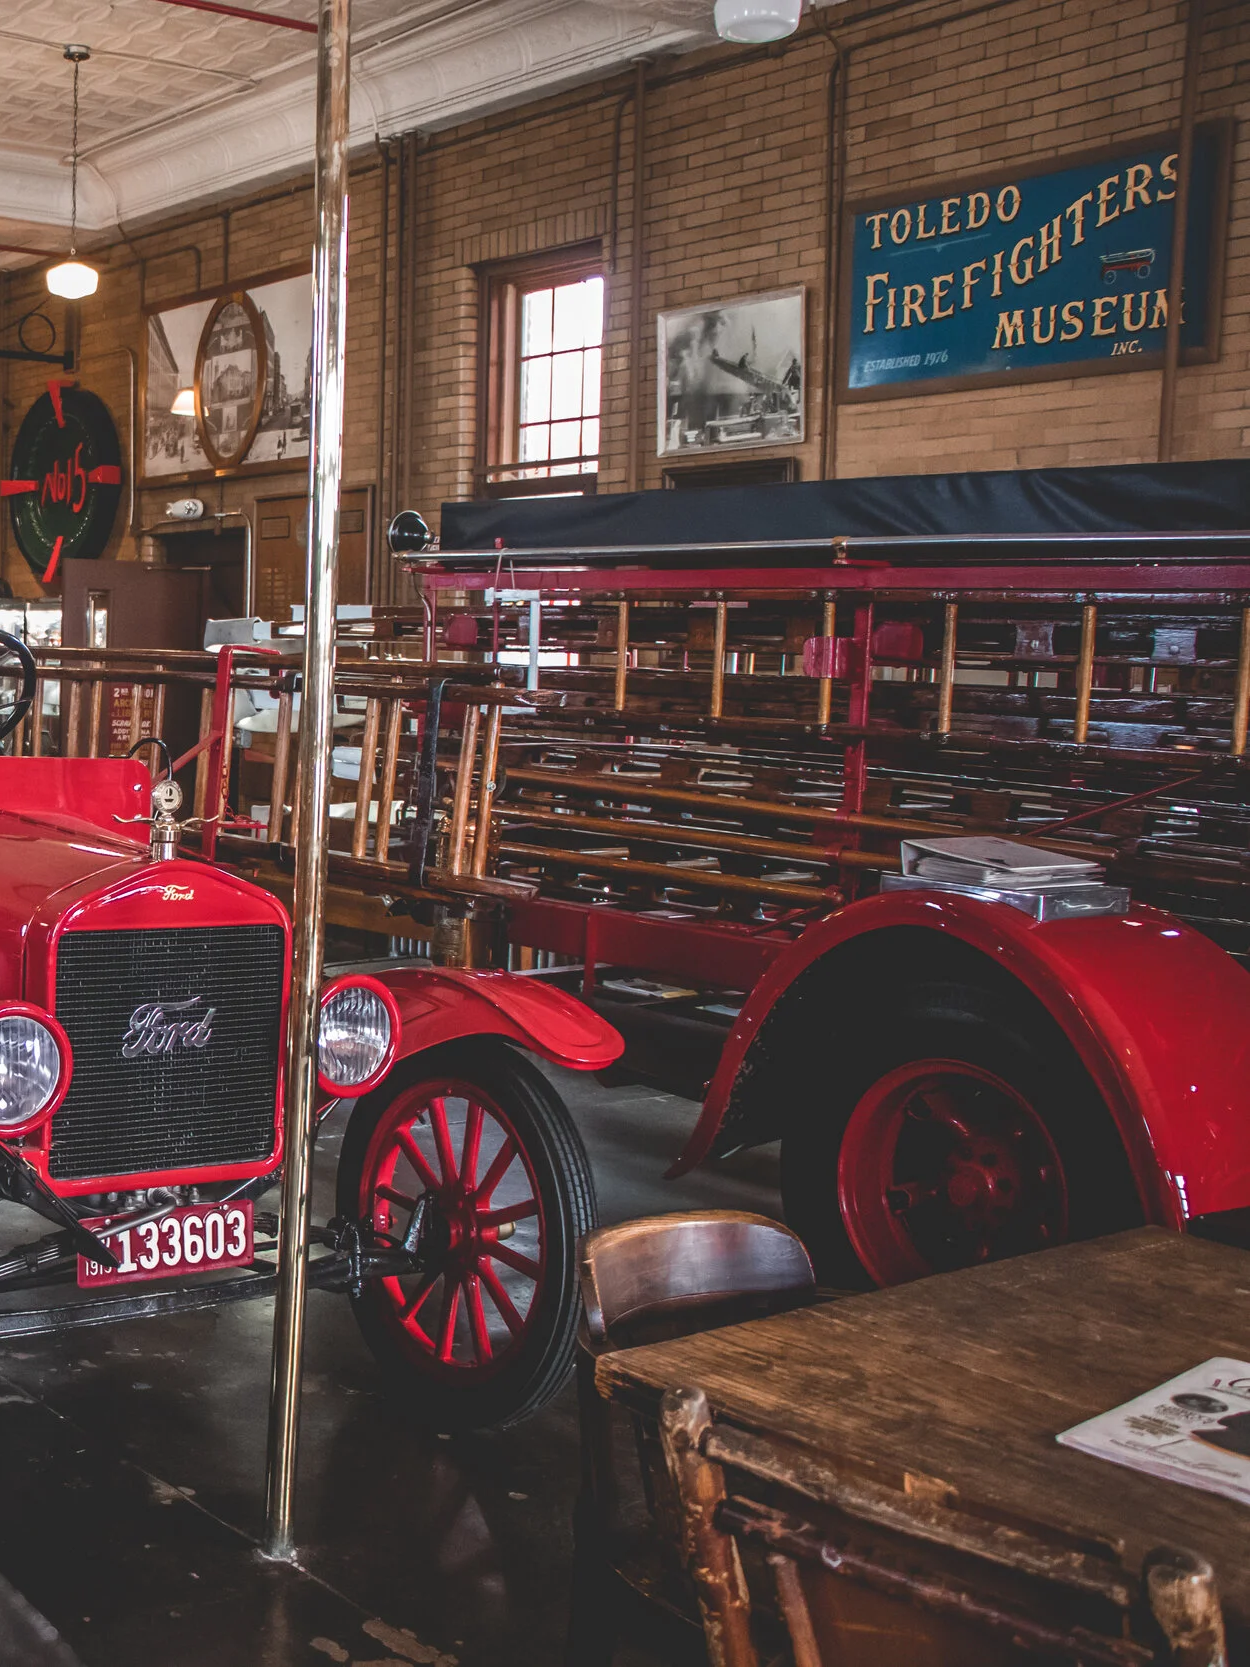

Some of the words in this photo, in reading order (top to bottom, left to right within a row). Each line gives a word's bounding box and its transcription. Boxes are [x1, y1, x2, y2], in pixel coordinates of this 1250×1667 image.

[862, 153, 1179, 334] FIREFIGHTERS
[865, 185, 1022, 250] TOLEDO
[991, 286, 1186, 350] MUSEUM
[1110, 339, 1143, 357] INC.
[863, 354, 920, 373] ESTABLISHED
[924, 349, 949, 367] 1976
[161, 884, 195, 901] Ford
[122, 996, 217, 1059] Ford
[116, 1209, 247, 1274] 133603
